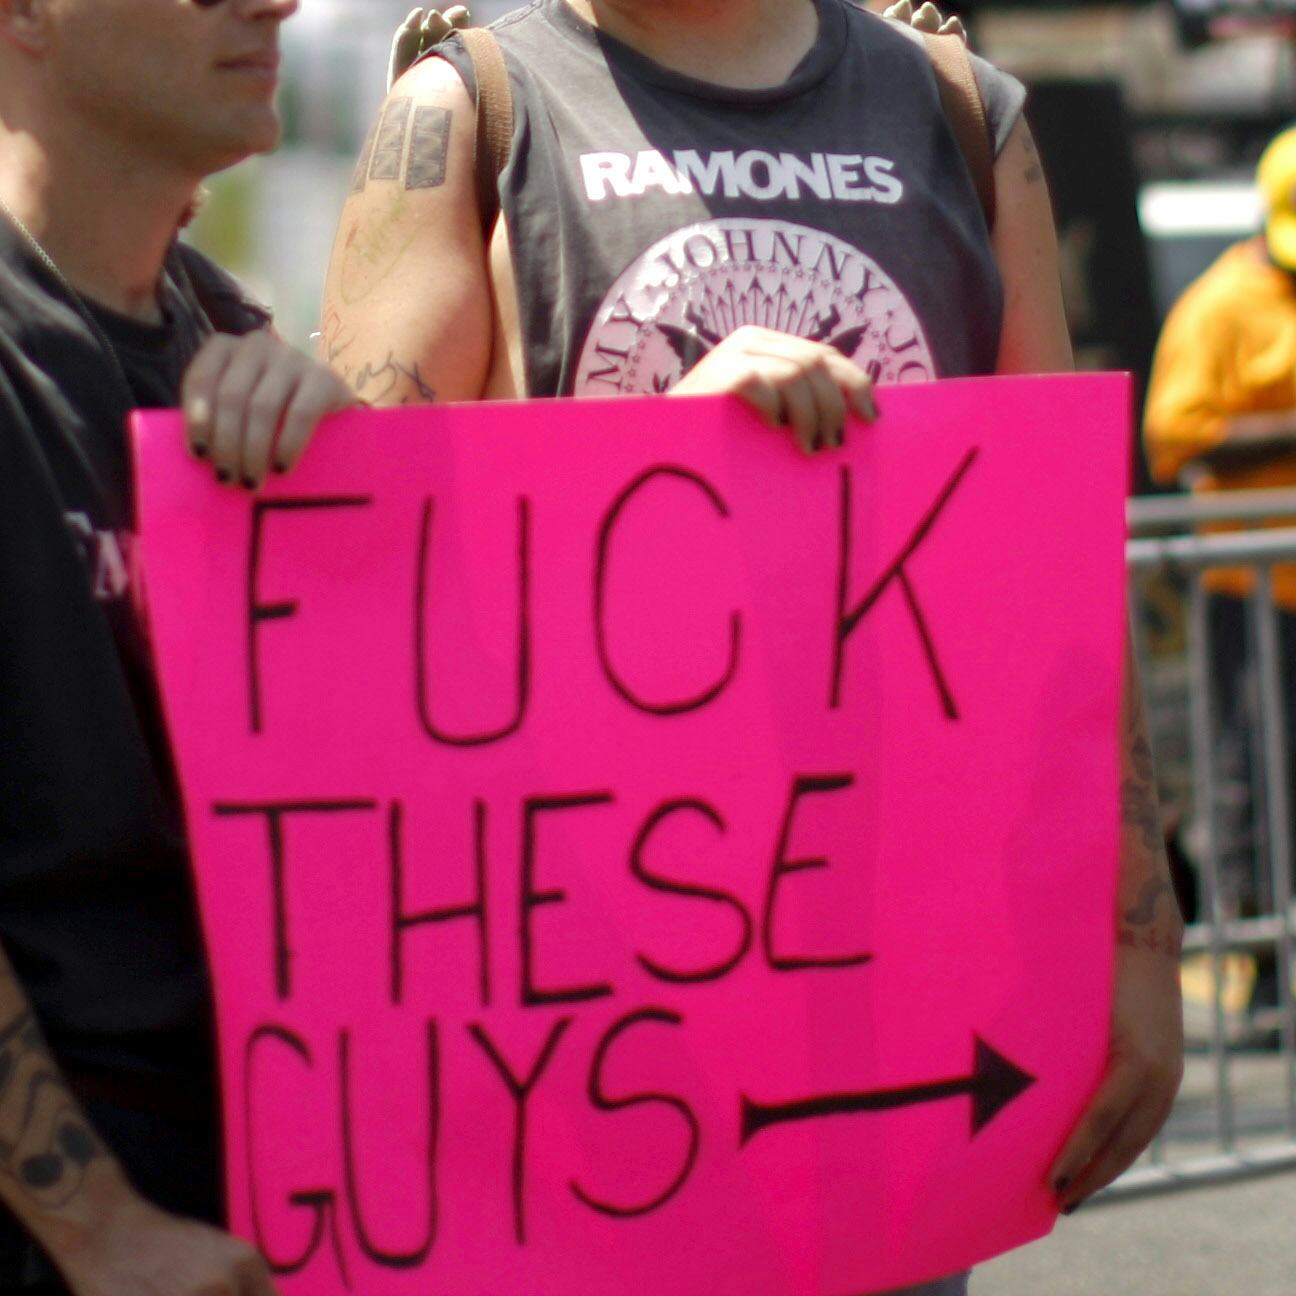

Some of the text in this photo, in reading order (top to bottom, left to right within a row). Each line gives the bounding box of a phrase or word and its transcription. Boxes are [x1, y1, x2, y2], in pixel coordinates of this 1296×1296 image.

[579, 149, 904, 204] RAMONES
[658, 228, 890, 301] JOHNNY
[249, 445, 979, 748] FUCK
[212, 772, 874, 1008] THESE
[243, 1006, 702, 1291] GUYS
